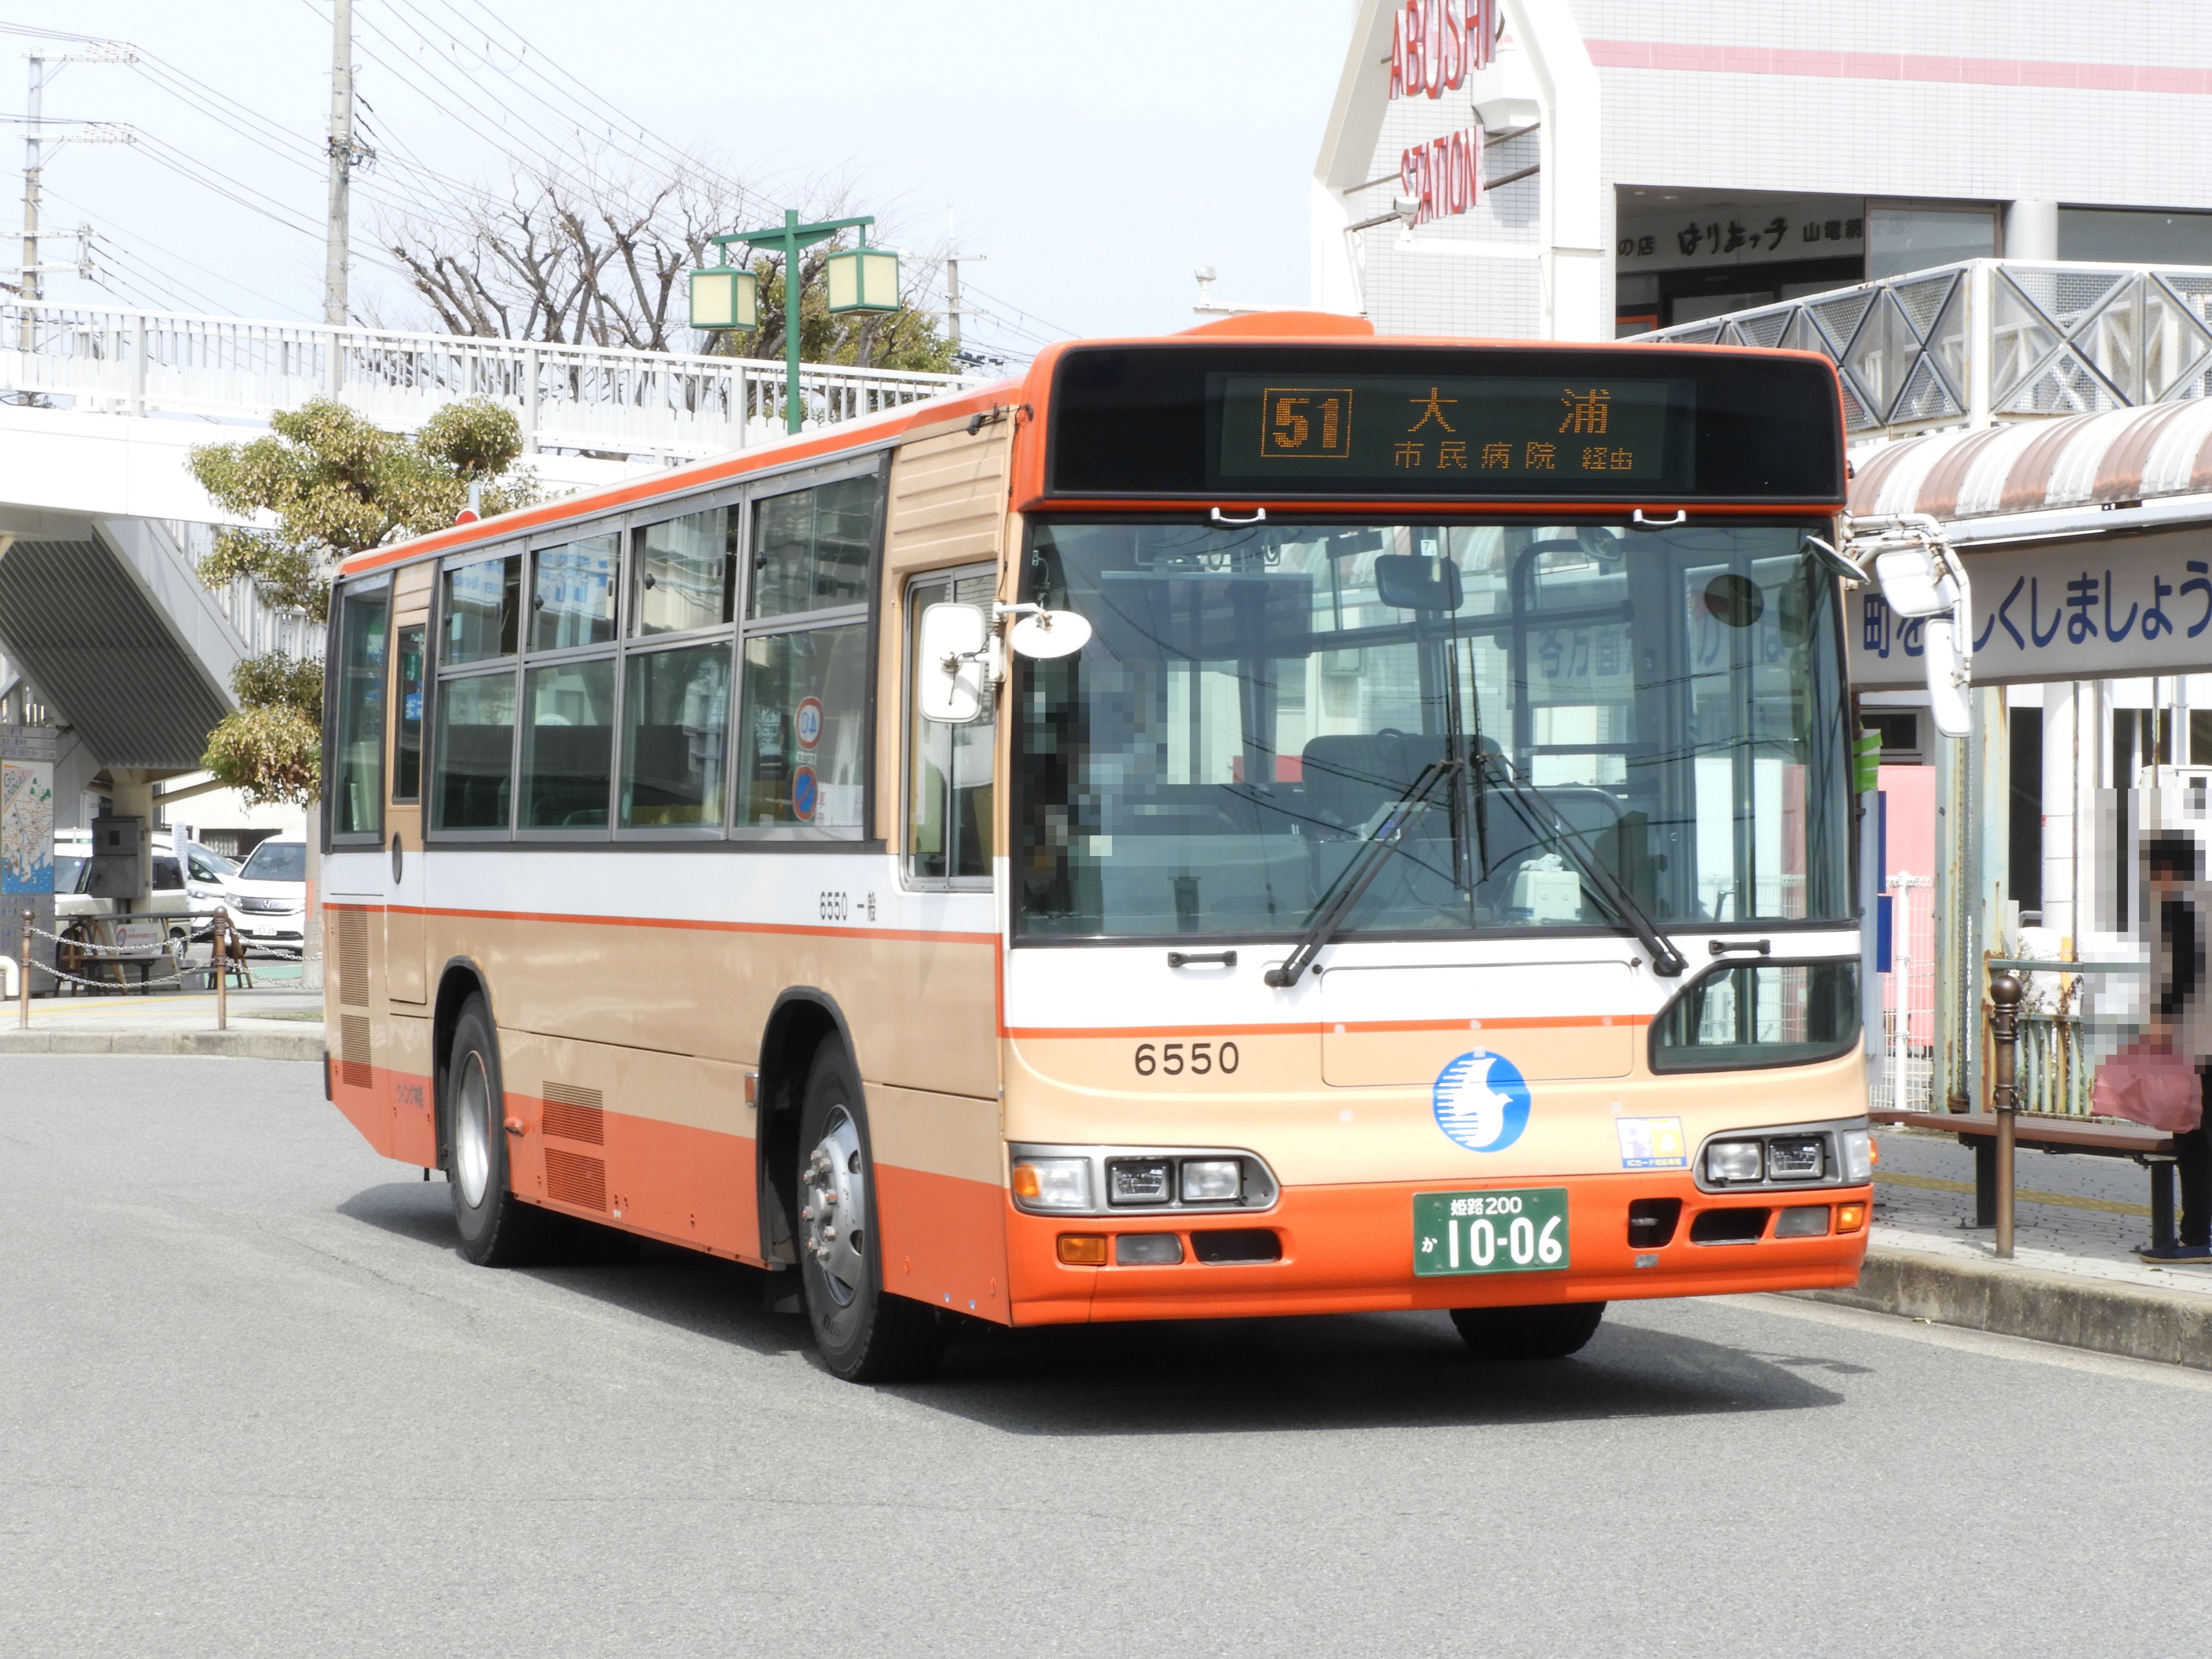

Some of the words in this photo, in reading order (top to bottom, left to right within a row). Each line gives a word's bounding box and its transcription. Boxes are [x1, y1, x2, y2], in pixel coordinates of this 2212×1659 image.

[1401, 125, 1484, 230] STATION
[1618, 234, 1655, 256] の店
[1272, 398, 1339, 448] 51
[1407, 387, 1611, 434] 大浦
[1394, 441, 1556, 469] 市民病院
[1582, 447, 1633, 470] 経由
[820, 891, 848, 921] 6550
[1135, 1041, 1239, 1076] 6550
[1421, 1236, 1438, 1253] か
[1448, 1215, 1562, 1268] 10-06
